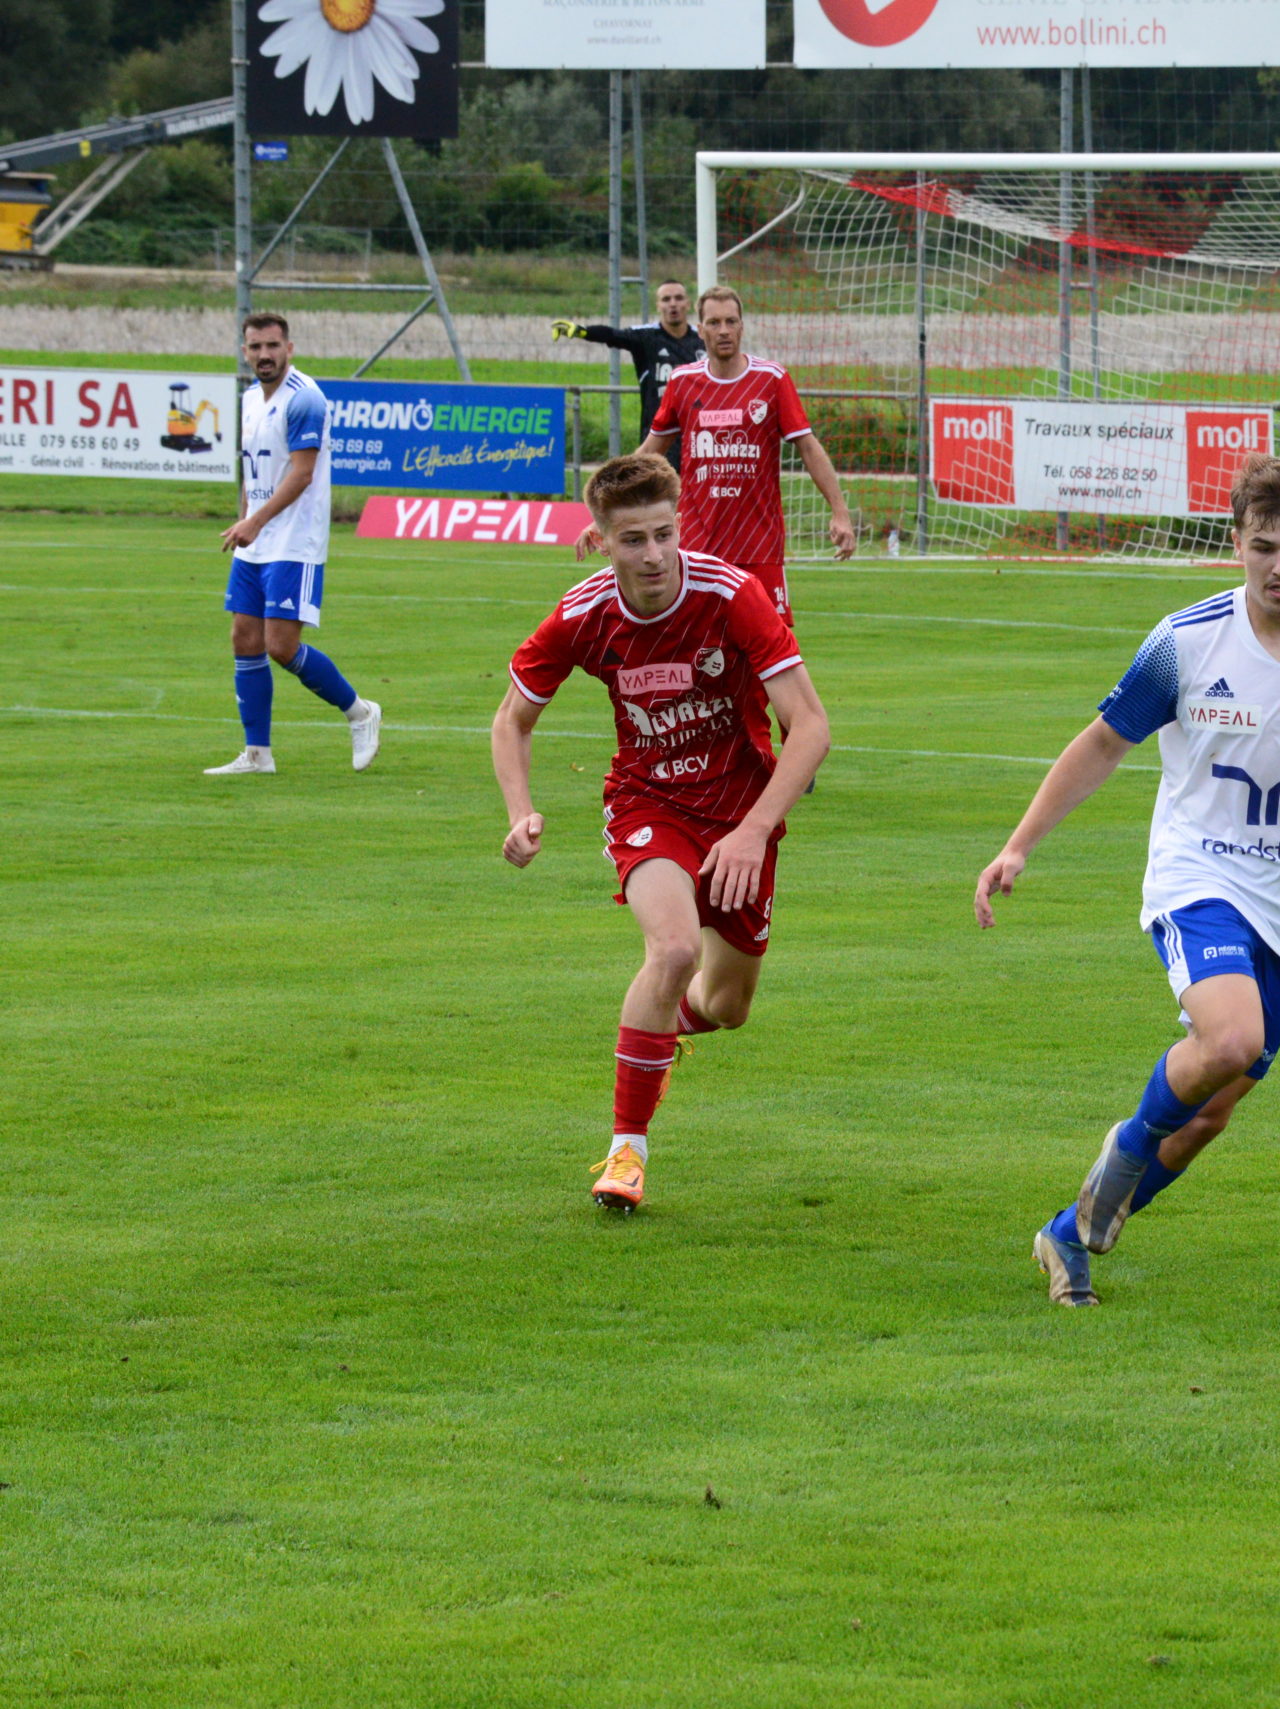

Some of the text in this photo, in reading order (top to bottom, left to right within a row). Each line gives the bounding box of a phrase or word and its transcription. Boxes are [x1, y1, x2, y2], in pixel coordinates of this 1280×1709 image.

[976, 18, 1167, 46] www.bollini.ch
[0, 378, 139, 429] RI SA
[943, 410, 1002, 441] moll
[1024, 417, 1175, 442] Travaux spéciaux
[1197, 418, 1259, 449] moll
[40, 434, 65, 448] 079
[71, 435, 96, 450] 658
[102, 436, 118, 450] 60
[123, 437, 140, 451] 49
[346, 438, 364, 454] 69
[365, 439, 383, 454] 69
[31, 453, 60, 467] Génie
[63, 455, 84, 469] civil
[102, 456, 161, 472] Rénovation
[163, 459, 176, 473] de
[178, 460, 231, 475] bâtiments
[1043, 464, 1158, 483] Tél. 058 226 82 50
[720, 486, 742, 497] BCV
[1058, 485, 1142, 500] www.moll.ch
[394, 499, 559, 543] YAPEAL
[622, 669, 689, 689] YAPEAL
[1204, 689, 1235, 699] adidas
[1188, 705, 1257, 728] YAPEAL
[672, 753, 709, 776] BCV
